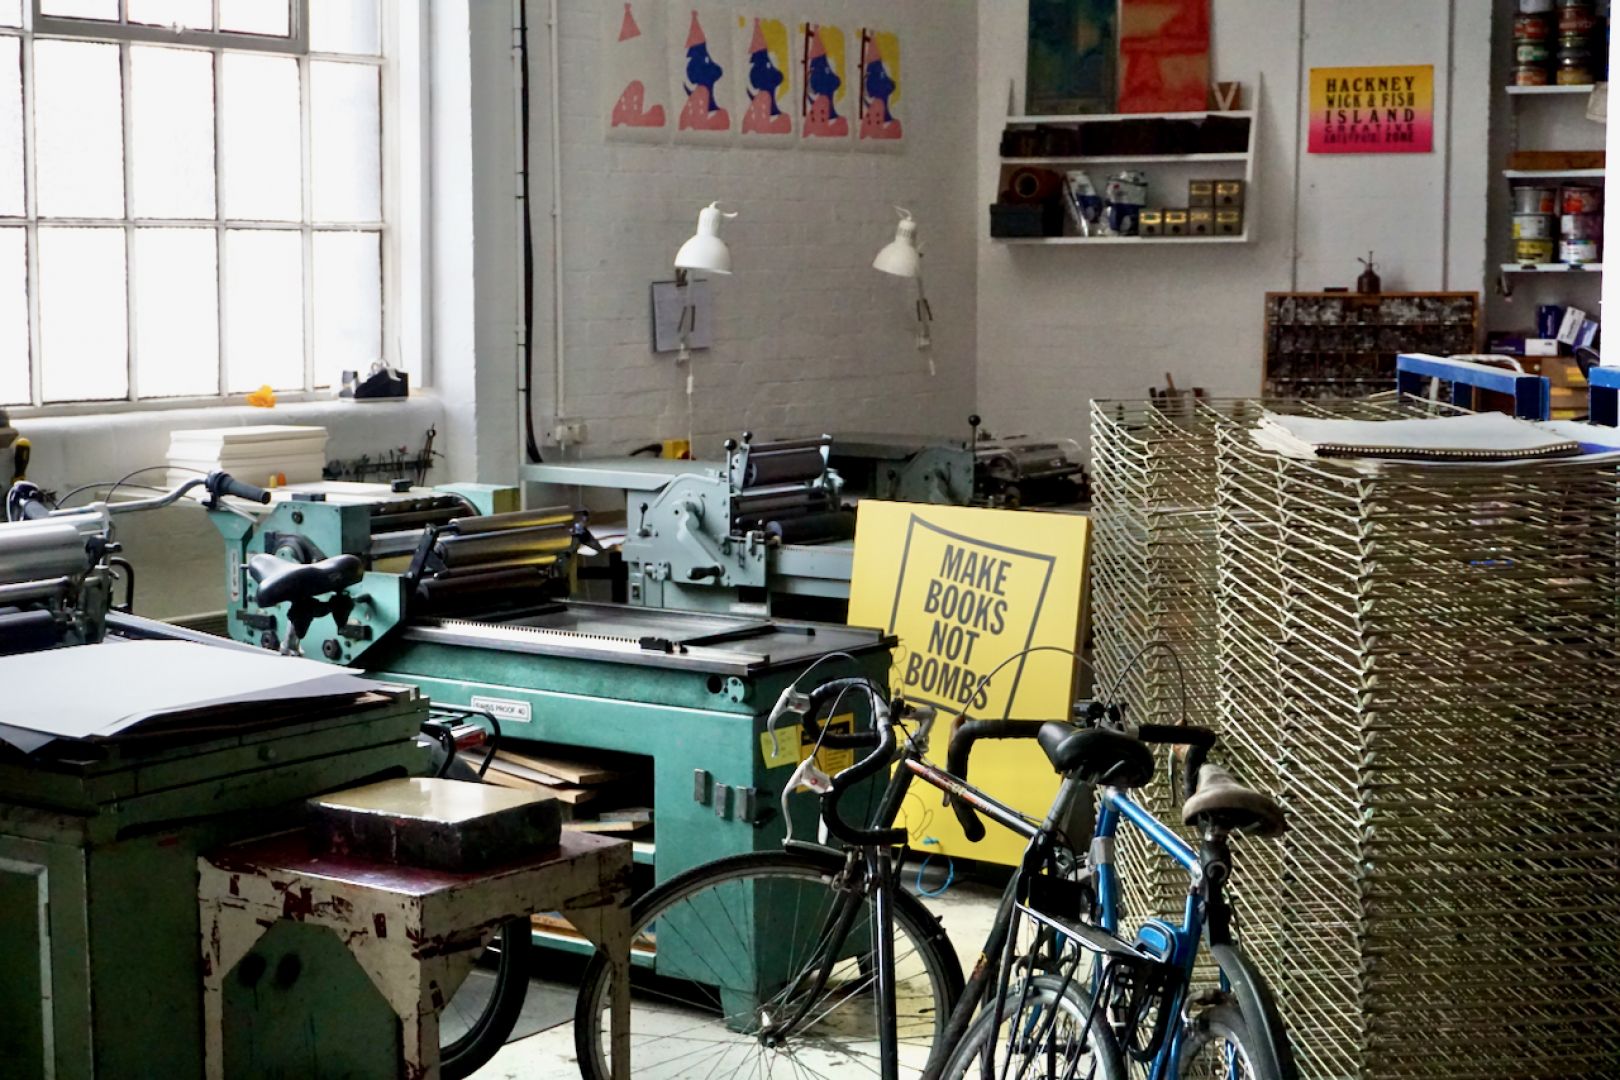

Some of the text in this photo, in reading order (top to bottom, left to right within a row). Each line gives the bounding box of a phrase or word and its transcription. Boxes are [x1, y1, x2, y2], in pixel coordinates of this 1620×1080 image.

[1326, 76, 1415, 92] HACKNEY
[1326, 93, 1415, 108] WICK & FISH
[1326, 109, 1415, 124] ISLAND
[939, 544, 1012, 596] MAKE
[923, 579, 1008, 635] BOOKS
[927, 620, 980, 665] NOT
[905, 652, 991, 710] BOMBS
[496, 704, 515, 713] PROOF
